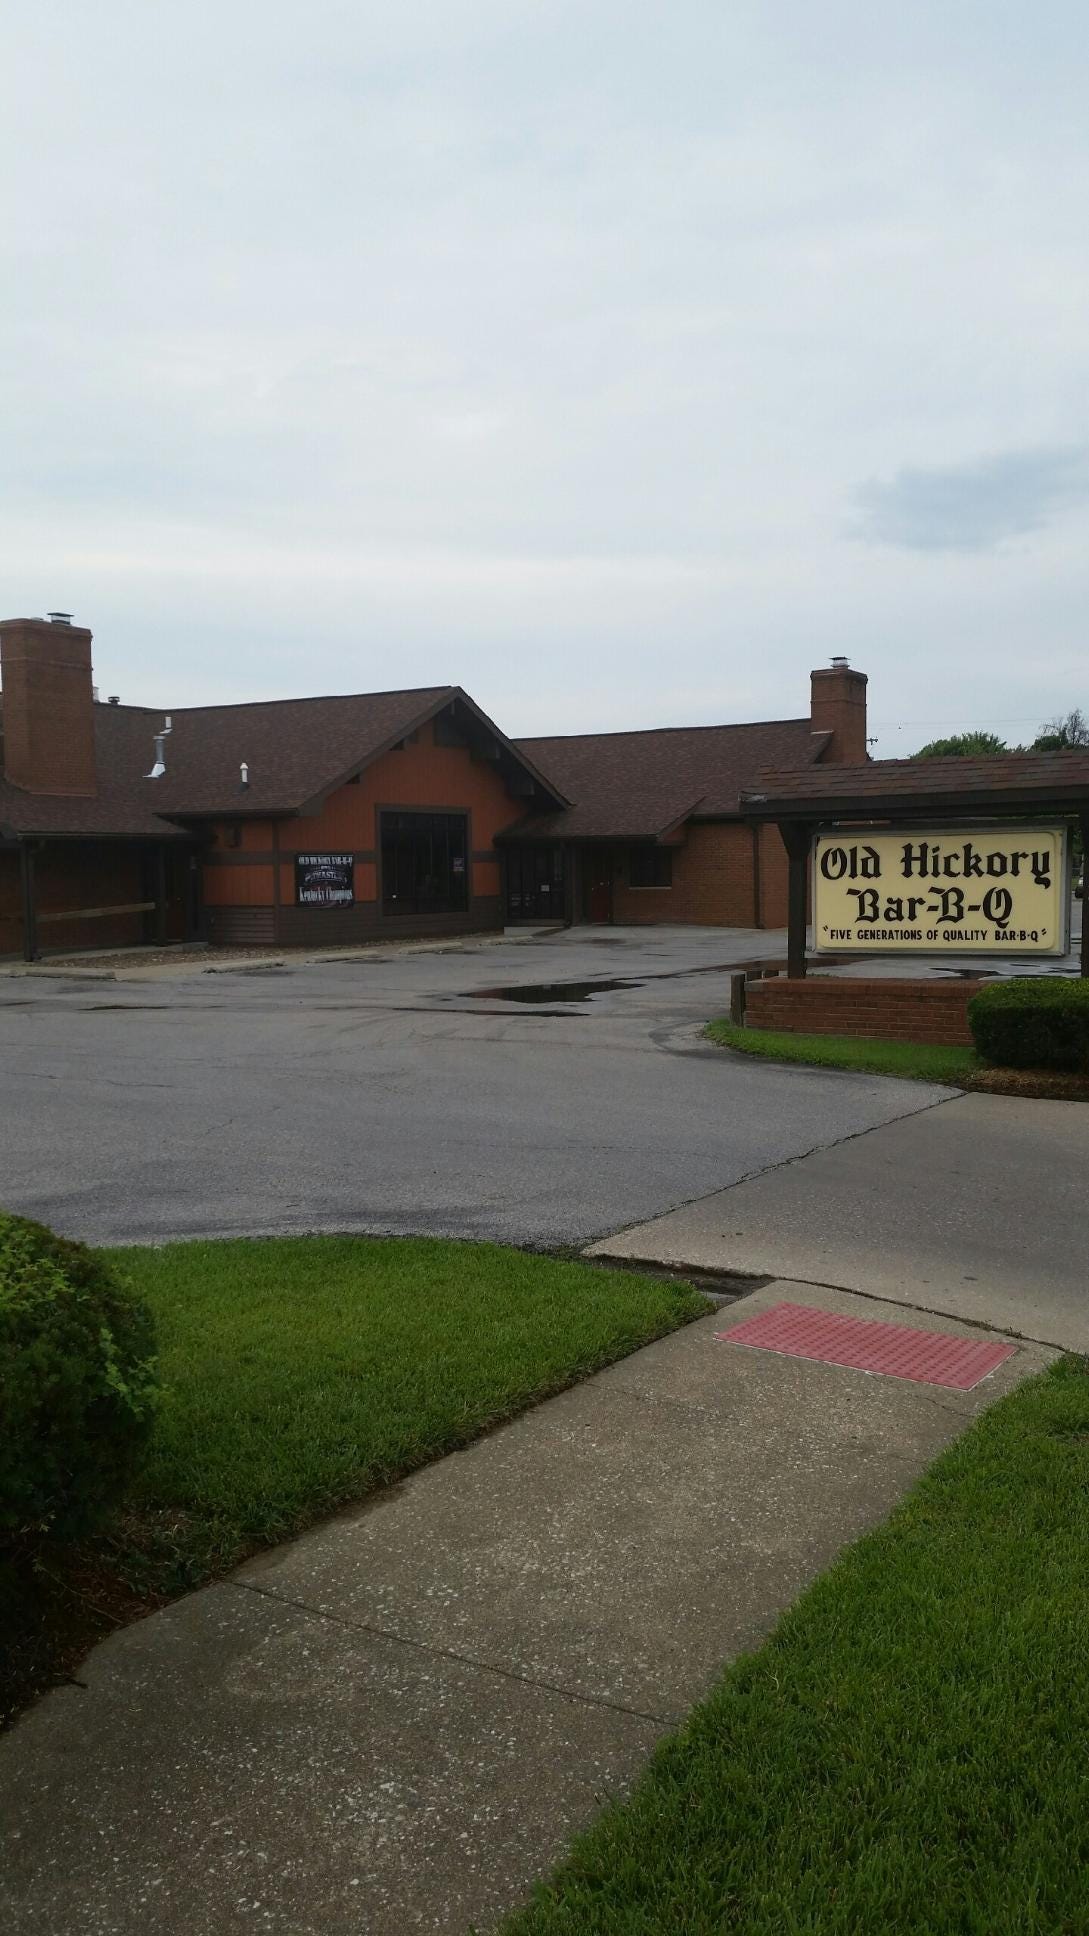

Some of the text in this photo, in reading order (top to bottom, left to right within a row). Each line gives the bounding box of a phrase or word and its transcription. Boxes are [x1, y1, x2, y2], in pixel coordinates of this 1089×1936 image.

[821, 843, 1051, 889] Old Hickory
[847, 886, 1013, 929] Bar-B-Q
[857, 929, 922, 941] GENERATIONS
[926, 929, 939, 941] OF
[943, 929, 988, 942] QUALITY
